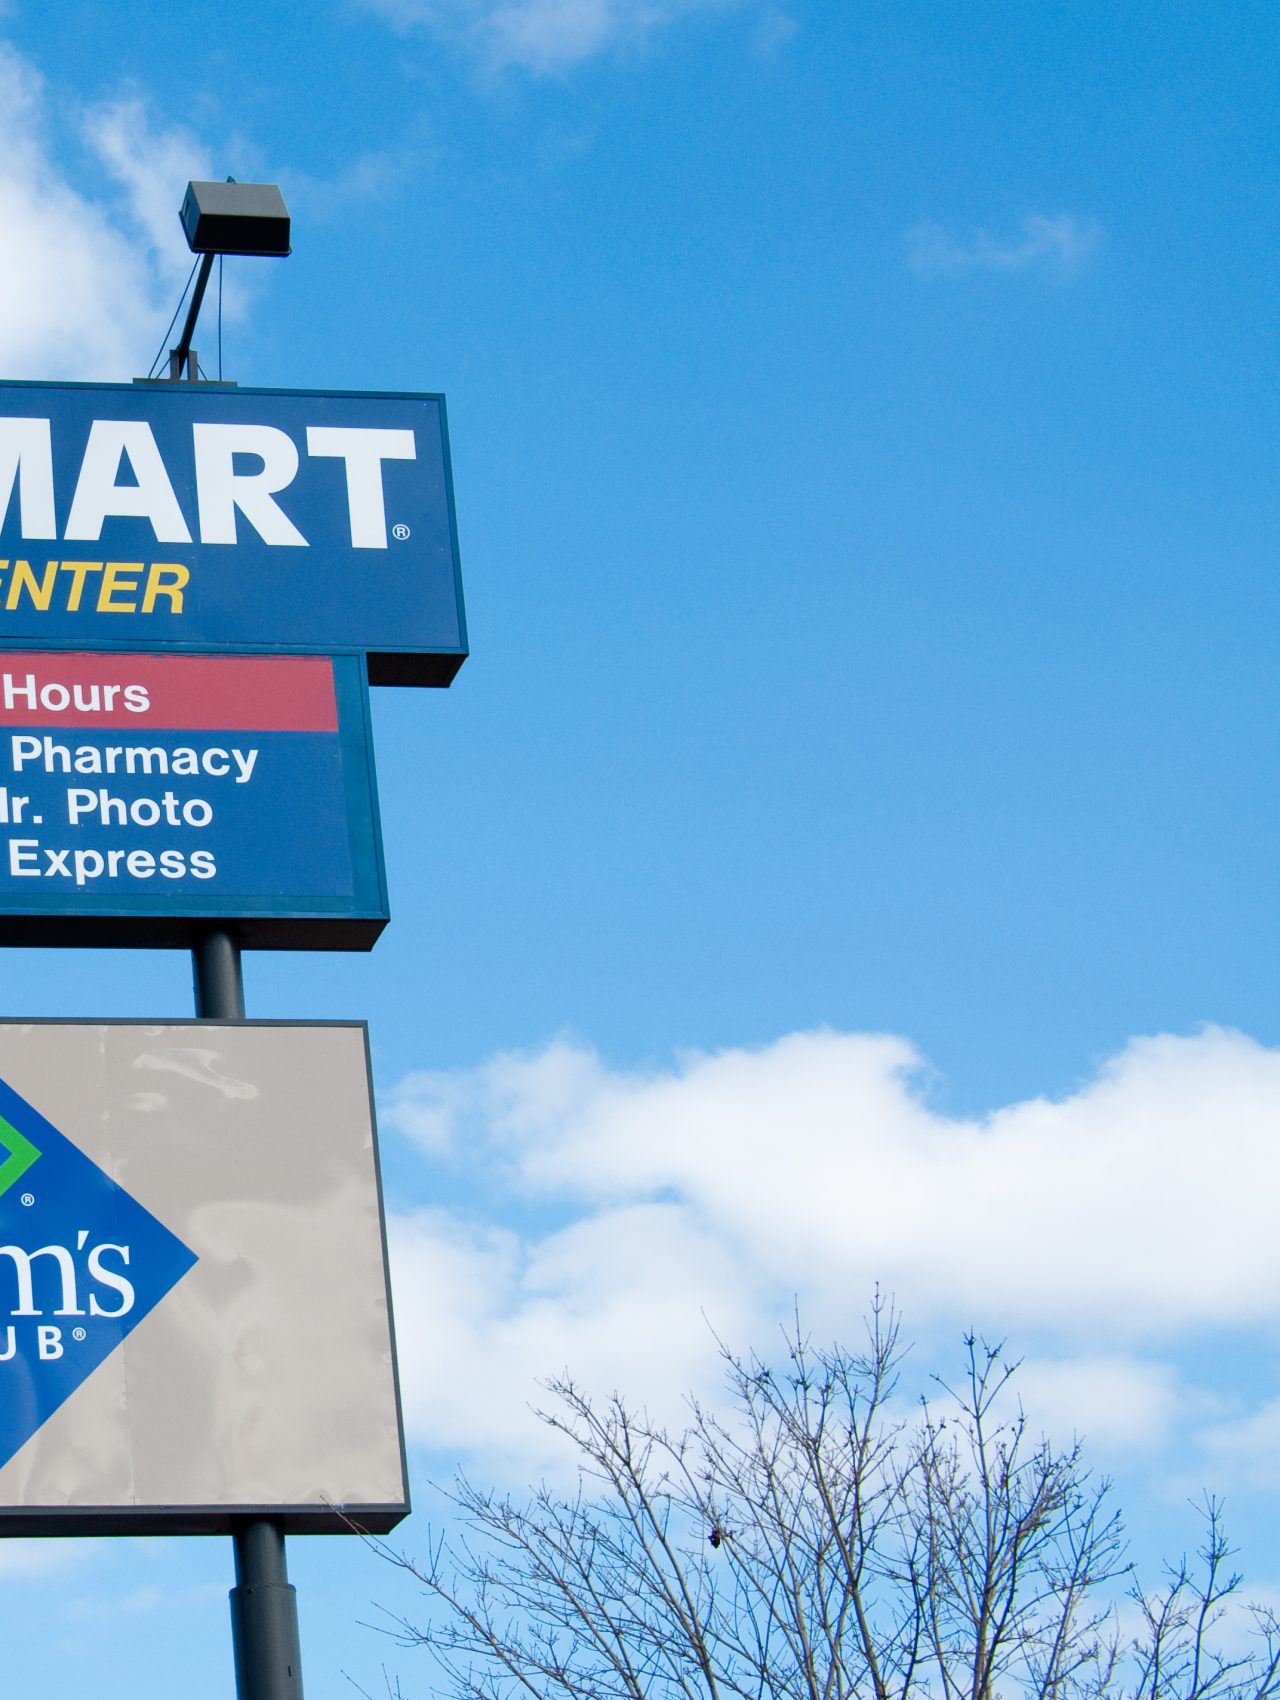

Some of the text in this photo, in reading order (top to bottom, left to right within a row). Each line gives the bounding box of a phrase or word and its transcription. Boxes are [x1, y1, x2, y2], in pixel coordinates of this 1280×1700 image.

[2, 673, 151, 713] Hours
[11, 735, 259, 783] Pharmacy
[67, 788, 213, 827] Photo
[9, 839, 217, 886] Express
